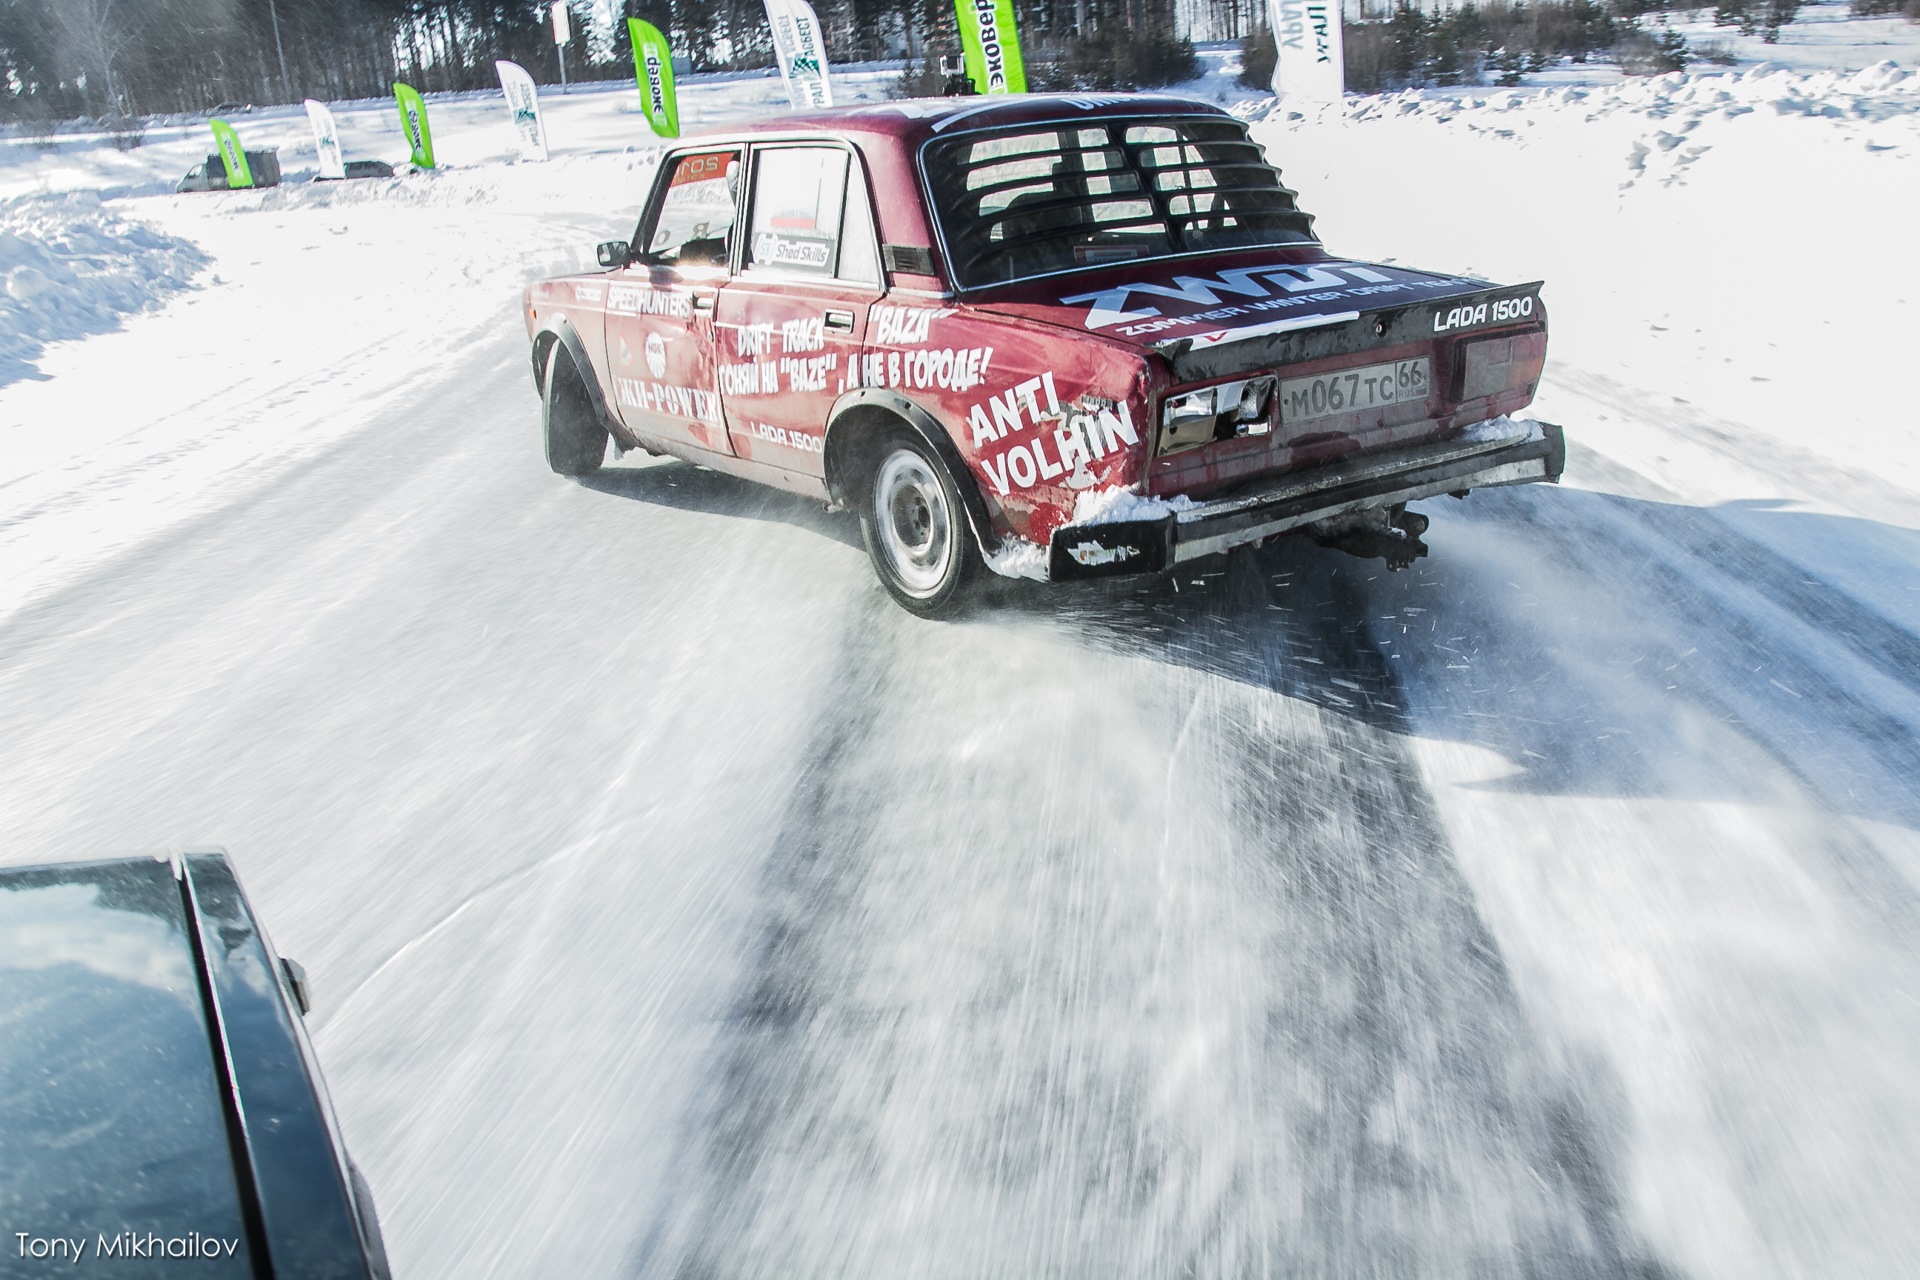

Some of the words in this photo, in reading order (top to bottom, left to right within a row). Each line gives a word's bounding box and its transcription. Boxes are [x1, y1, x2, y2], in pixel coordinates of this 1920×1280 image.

[1115, 306, 1250, 336] ZOMMER
[1243, 291, 1351, 311] WINTER
[1345, 283, 1415, 297] DRIFT
[1434, 303, 1488, 332] LADA
[1492, 296, 1533, 322] 1500
[738, 322, 774, 357] DRIFT
[761, 360, 780, 394] НА
[862, 352, 885, 389] НЕ
[888, 351, 901, 389] В
[905, 346, 994, 392] ГОРОДЕ!
[1399, 361, 1422, 388] 66
[969, 371, 1060, 449] ANTI
[751, 422, 787, 447] LADA
[788, 430, 822, 451] 1500
